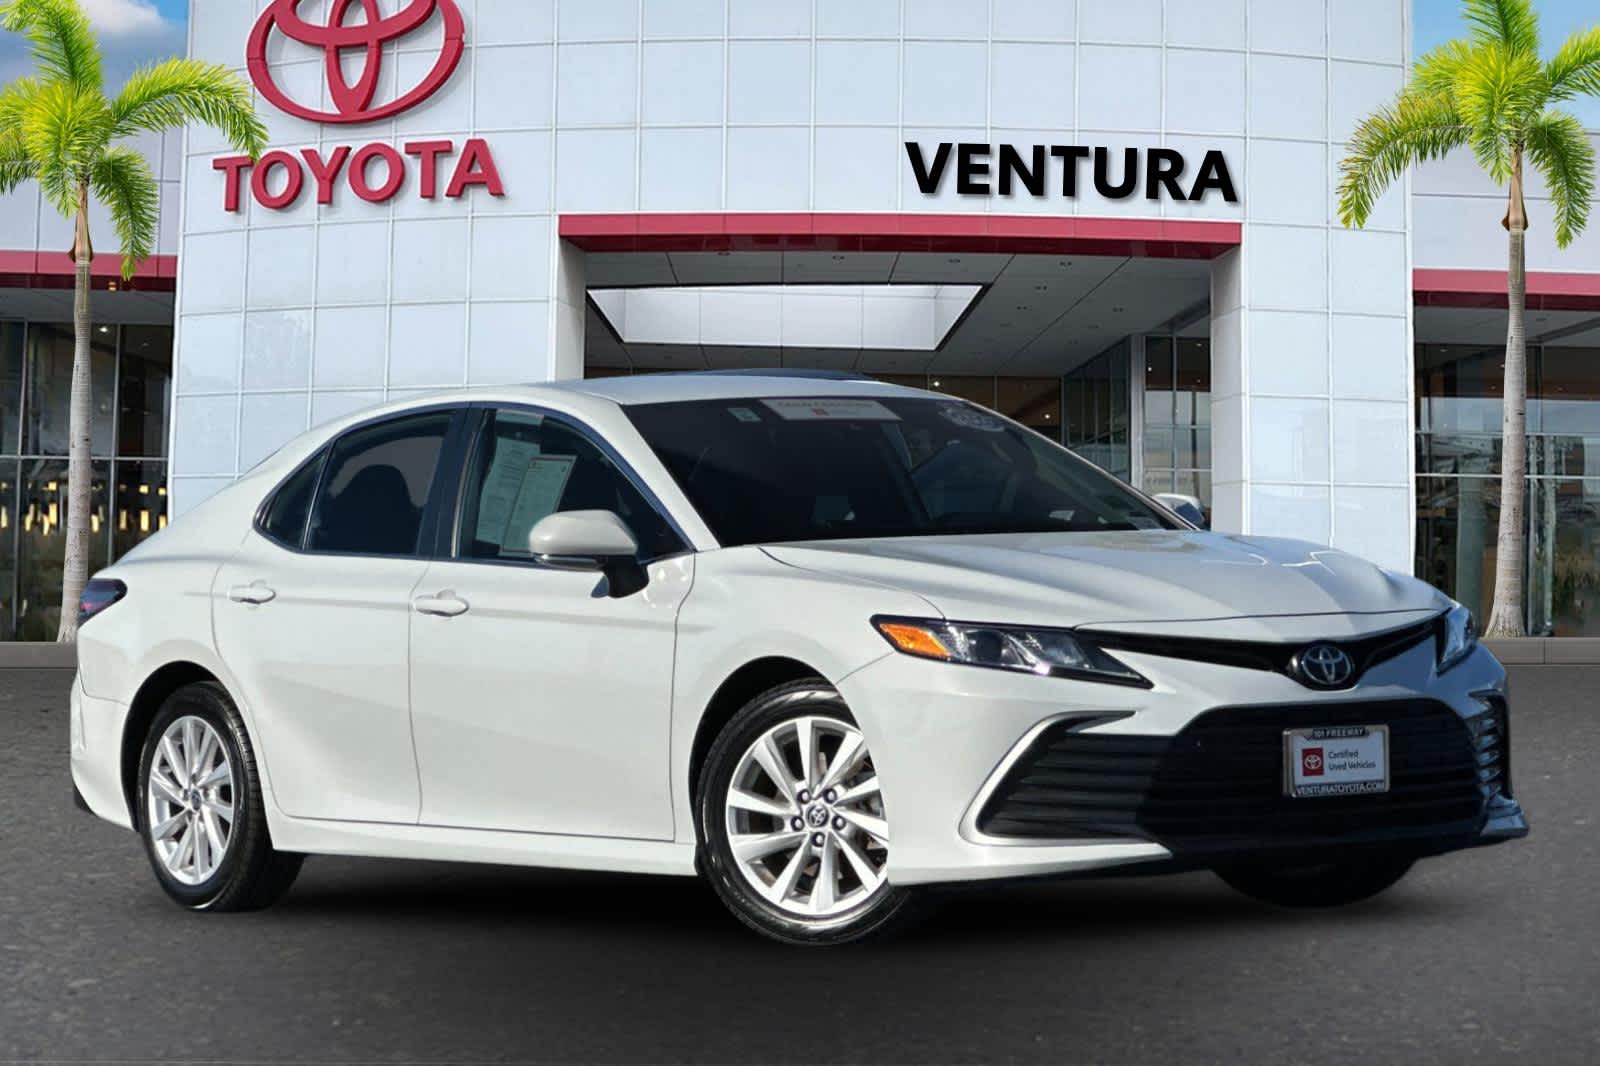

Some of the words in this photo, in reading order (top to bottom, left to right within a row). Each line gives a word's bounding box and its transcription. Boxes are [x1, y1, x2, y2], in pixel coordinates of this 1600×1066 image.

[212, 138, 505, 213] TOYOTA
[904, 142, 1238, 202] VENTURA
[1327, 727, 1364, 737] FREEWAY
[1328, 749, 1359, 760] Certified
[1328, 762, 1347, 771] Used
[1348, 760, 1377, 770] Vehicles
[1296, 782, 1386, 797] VENTURATOYOTA.COM
